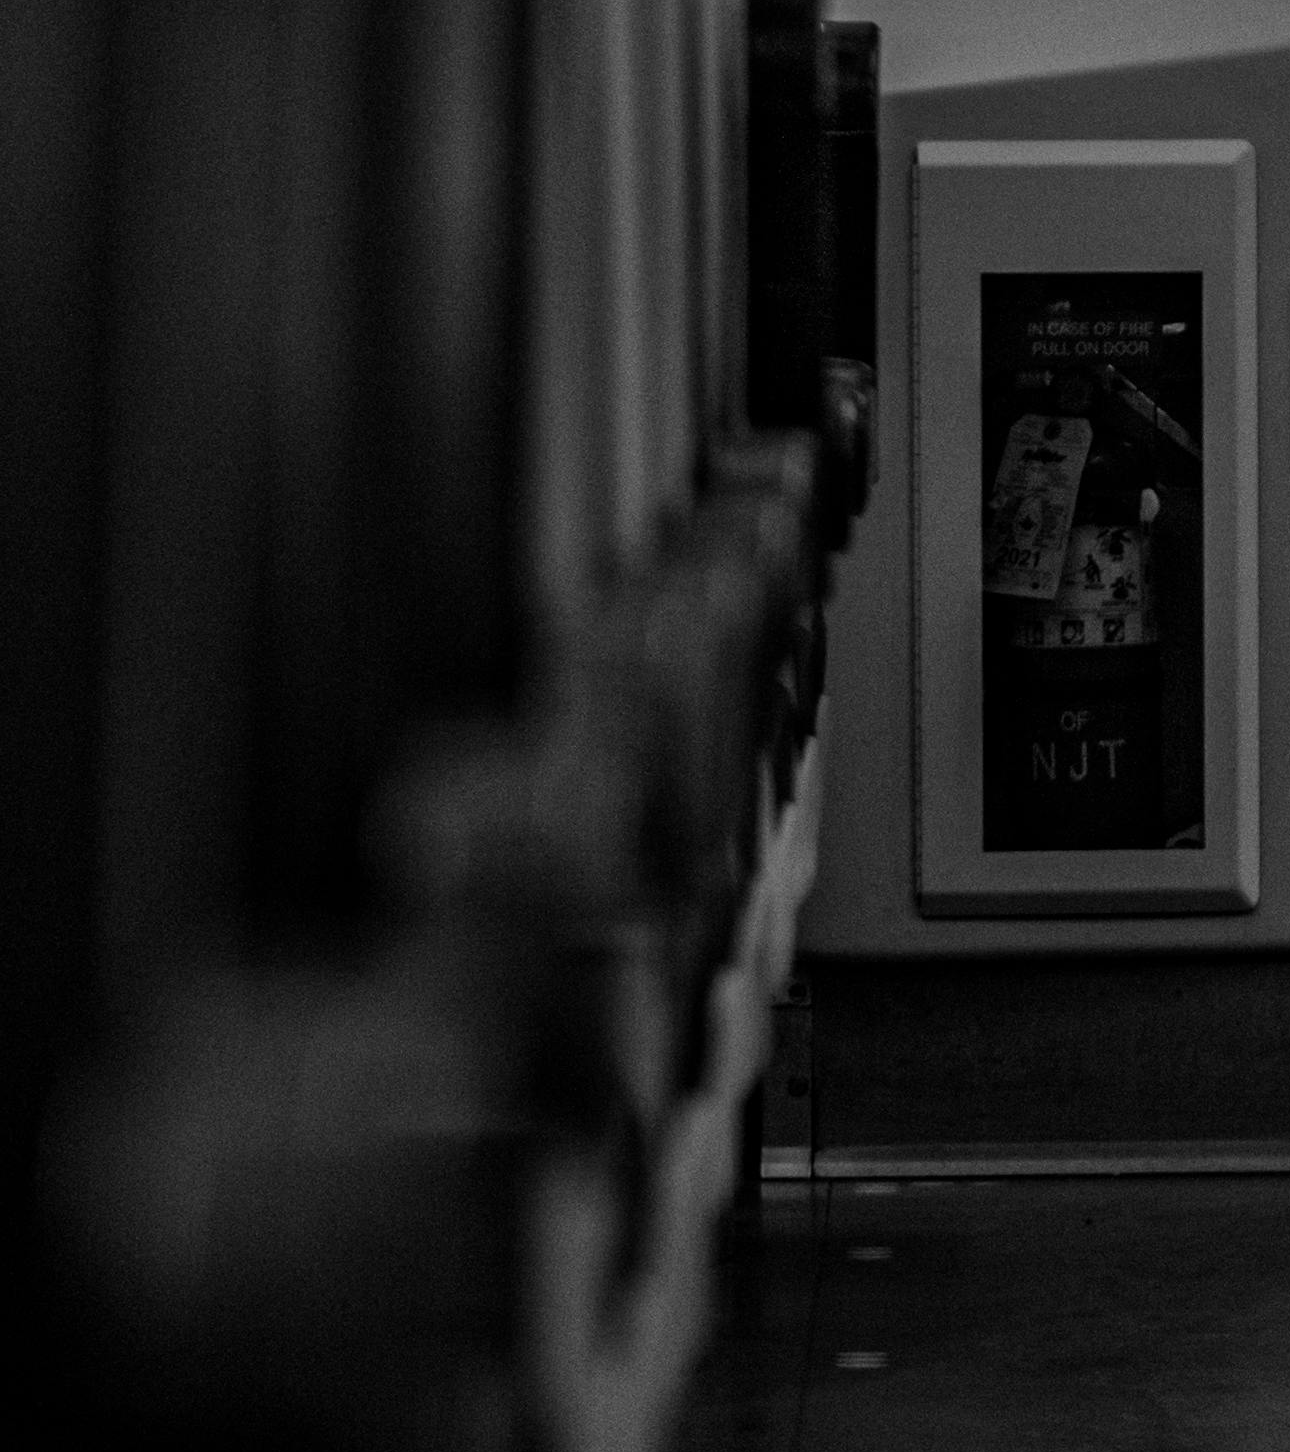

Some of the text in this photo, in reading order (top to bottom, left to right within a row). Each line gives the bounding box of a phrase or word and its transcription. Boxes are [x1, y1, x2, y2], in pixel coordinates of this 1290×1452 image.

[1027, 321, 1155, 336] IN CASE OF FIRE
[1075, 340, 1099, 355] ON
[1103, 340, 1150, 356] DOOR
[996, 545, 1041, 568] 2021
[1060, 709, 1089, 732] OF
[1031, 739, 1127, 783] NJT
